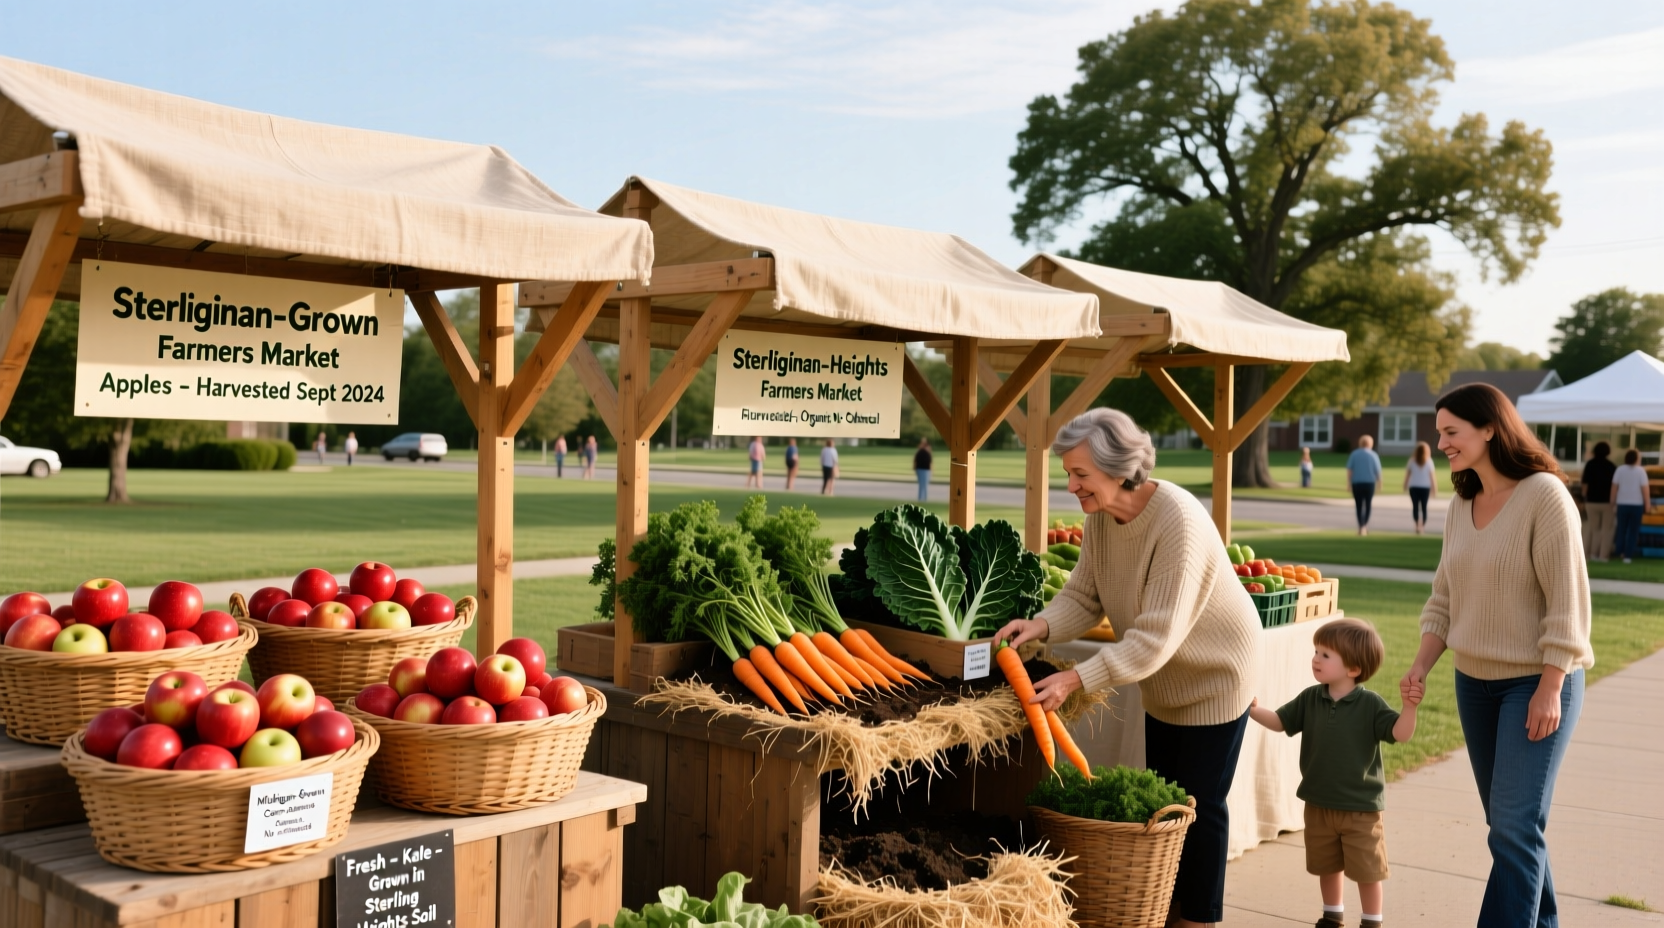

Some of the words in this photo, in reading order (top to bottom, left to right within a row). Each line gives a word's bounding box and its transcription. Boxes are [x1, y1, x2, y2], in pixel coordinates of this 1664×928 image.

[112, 286, 379, 336] Sterliginan-Grown
[158, 335, 254, 363] Farmers
[261, 341, 340, 369] Market
[733, 347, 888, 381] Sterliginan-Heights
[99, 372, 172, 399] Apples
[196, 376, 291, 400] Harvested
[296, 382, 337, 406] Sept
[341, 384, 385, 403] 2024
[761, 380, 814, 399] Farmers
[817, 382, 863, 401] Market
[346, 853, 386, 877] Fresh
[402, 845, 432, 865] Kale
[369, 874, 410, 892] Grown
[365, 891, 419, 915] Sterling
[411, 904, 437, 925] Soil
